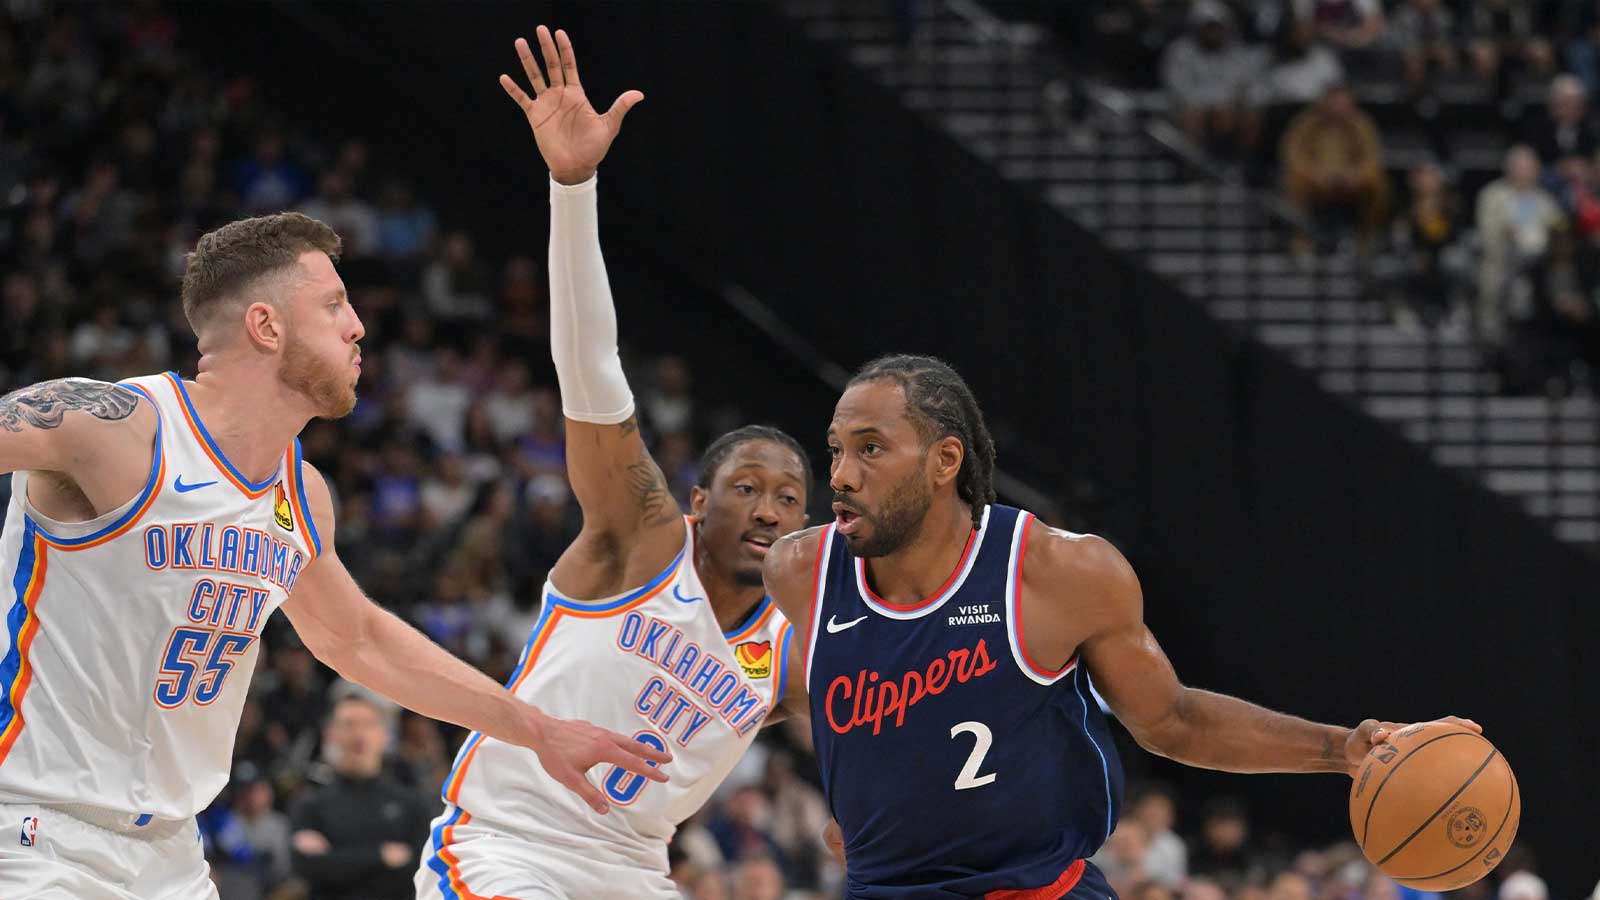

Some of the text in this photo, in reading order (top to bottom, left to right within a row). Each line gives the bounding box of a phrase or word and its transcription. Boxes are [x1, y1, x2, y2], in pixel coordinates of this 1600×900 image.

[144, 523, 303, 595] OKLAHOMA
[187, 579, 270, 632] CITY
[948, 613, 1001, 626] RWANDA
[958, 604, 989, 615] VISIT
[153, 626, 258, 709] 55
[617, 610, 769, 738] OKLAHOMA
[825, 638, 998, 735] Clippers
[634, 676, 713, 747] CITY
[950, 721, 997, 790] 2
